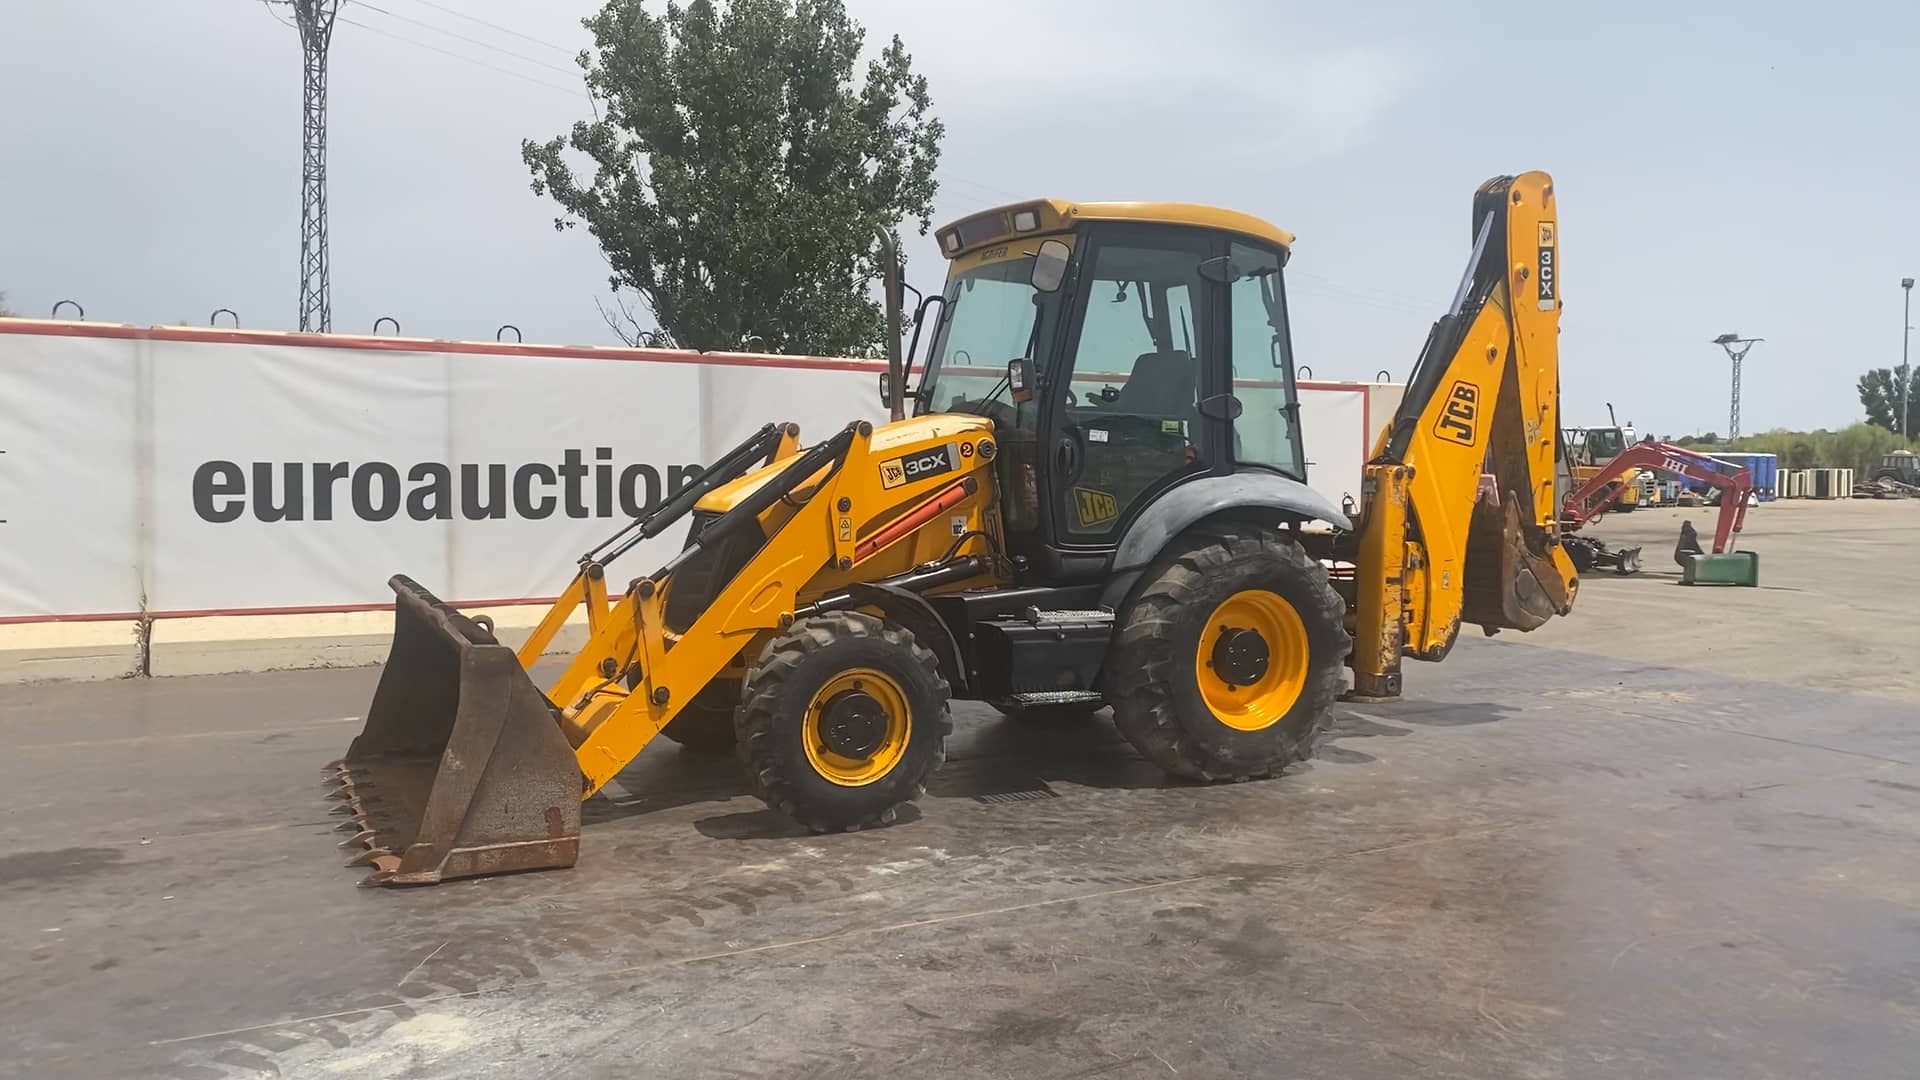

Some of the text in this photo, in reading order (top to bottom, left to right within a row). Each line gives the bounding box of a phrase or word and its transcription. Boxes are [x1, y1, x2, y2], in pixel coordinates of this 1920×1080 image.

[1541, 252, 1552, 296] 3CX
[1441, 386, 1476, 440] JCB
[905, 453, 946, 475] 3CX
[1081, 492, 1116, 522] JCB
